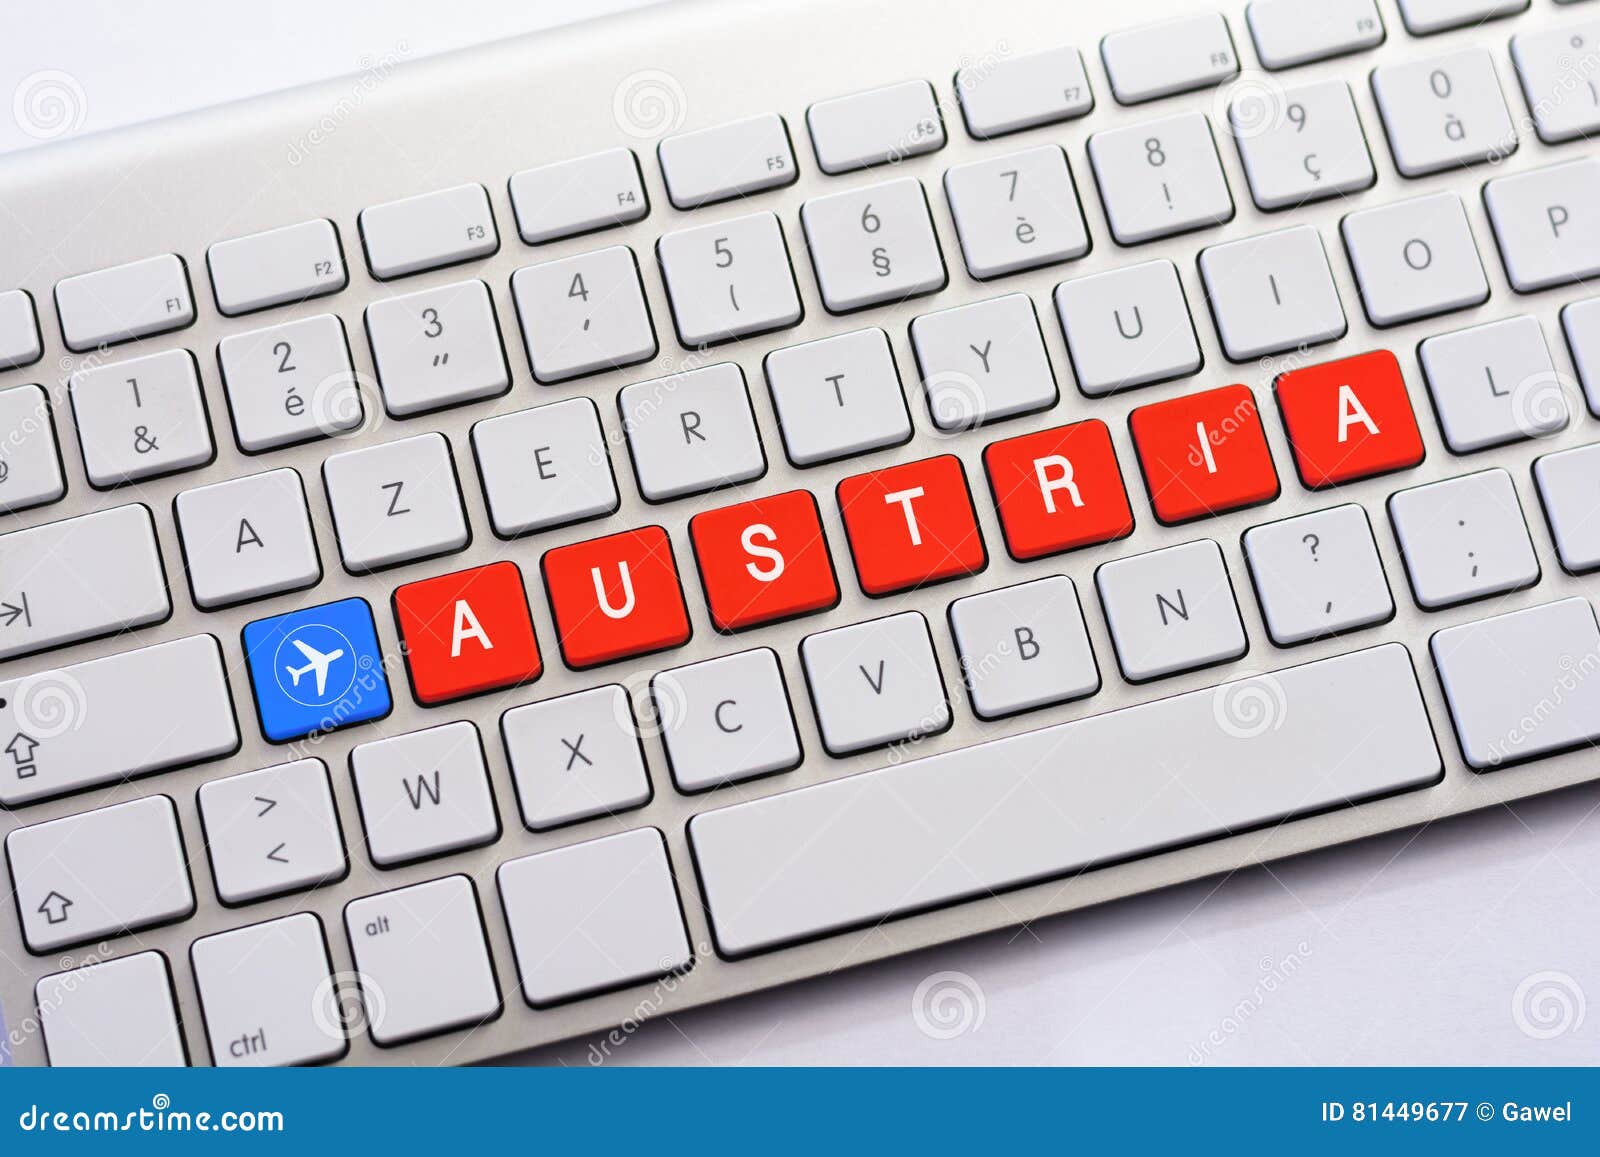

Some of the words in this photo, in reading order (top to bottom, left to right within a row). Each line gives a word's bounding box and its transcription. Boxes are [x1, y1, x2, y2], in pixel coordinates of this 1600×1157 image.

[1356, 18, 1375, 34] F9
[1210, 51, 1229, 66] F8
[1063, 86, 1082, 102] F7
[1429, 69, 1452, 99] 0
[1286, 103, 1307, 133] 9
[1444, 114, 1466, 142] à
[766, 155, 786, 171] F5
[1144, 137, 1166, 167] 8
[1303, 153, 1321, 182] ç
[616, 190, 637, 207] F4
[999, 170, 1018, 202] 7
[466, 225, 486, 241] F3
[861, 203, 881, 234] 6
[1015, 216, 1036, 244] è
[1546, 205, 1569, 238] P
[314, 260, 334, 277] F2
[714, 237, 734, 269] 5
[1402, 238, 1432, 271] O
[567, 272, 589, 302] 4
[165, 297, 183, 314] F1
[421, 307, 443, 339] 3
[1113, 305, 1144, 340] U
[272, 341, 297, 373] 2
[969, 340, 992, 374] Y
[126, 378, 142, 408] 1
[824, 374, 845, 407] T
[1485, 366, 1510, 398] L
[284, 386, 305, 417] é
[134, 425, 160, 454] &
[679, 410, 706, 445] R
[533, 446, 557, 480] E
[381, 481, 411, 517] Z
[236, 518, 265, 554] A
[1302, 533, 1320, 562] ?
[1155, 588, 1189, 626] N
[1014, 626, 1040, 661] B
[859, 659, 885, 695] V
[714, 699, 743, 734] C
[560, 733, 593, 771] X
[402, 770, 441, 811] W
[365, 916, 390, 937] alt
[229, 1027, 268, 1059] ctrl
